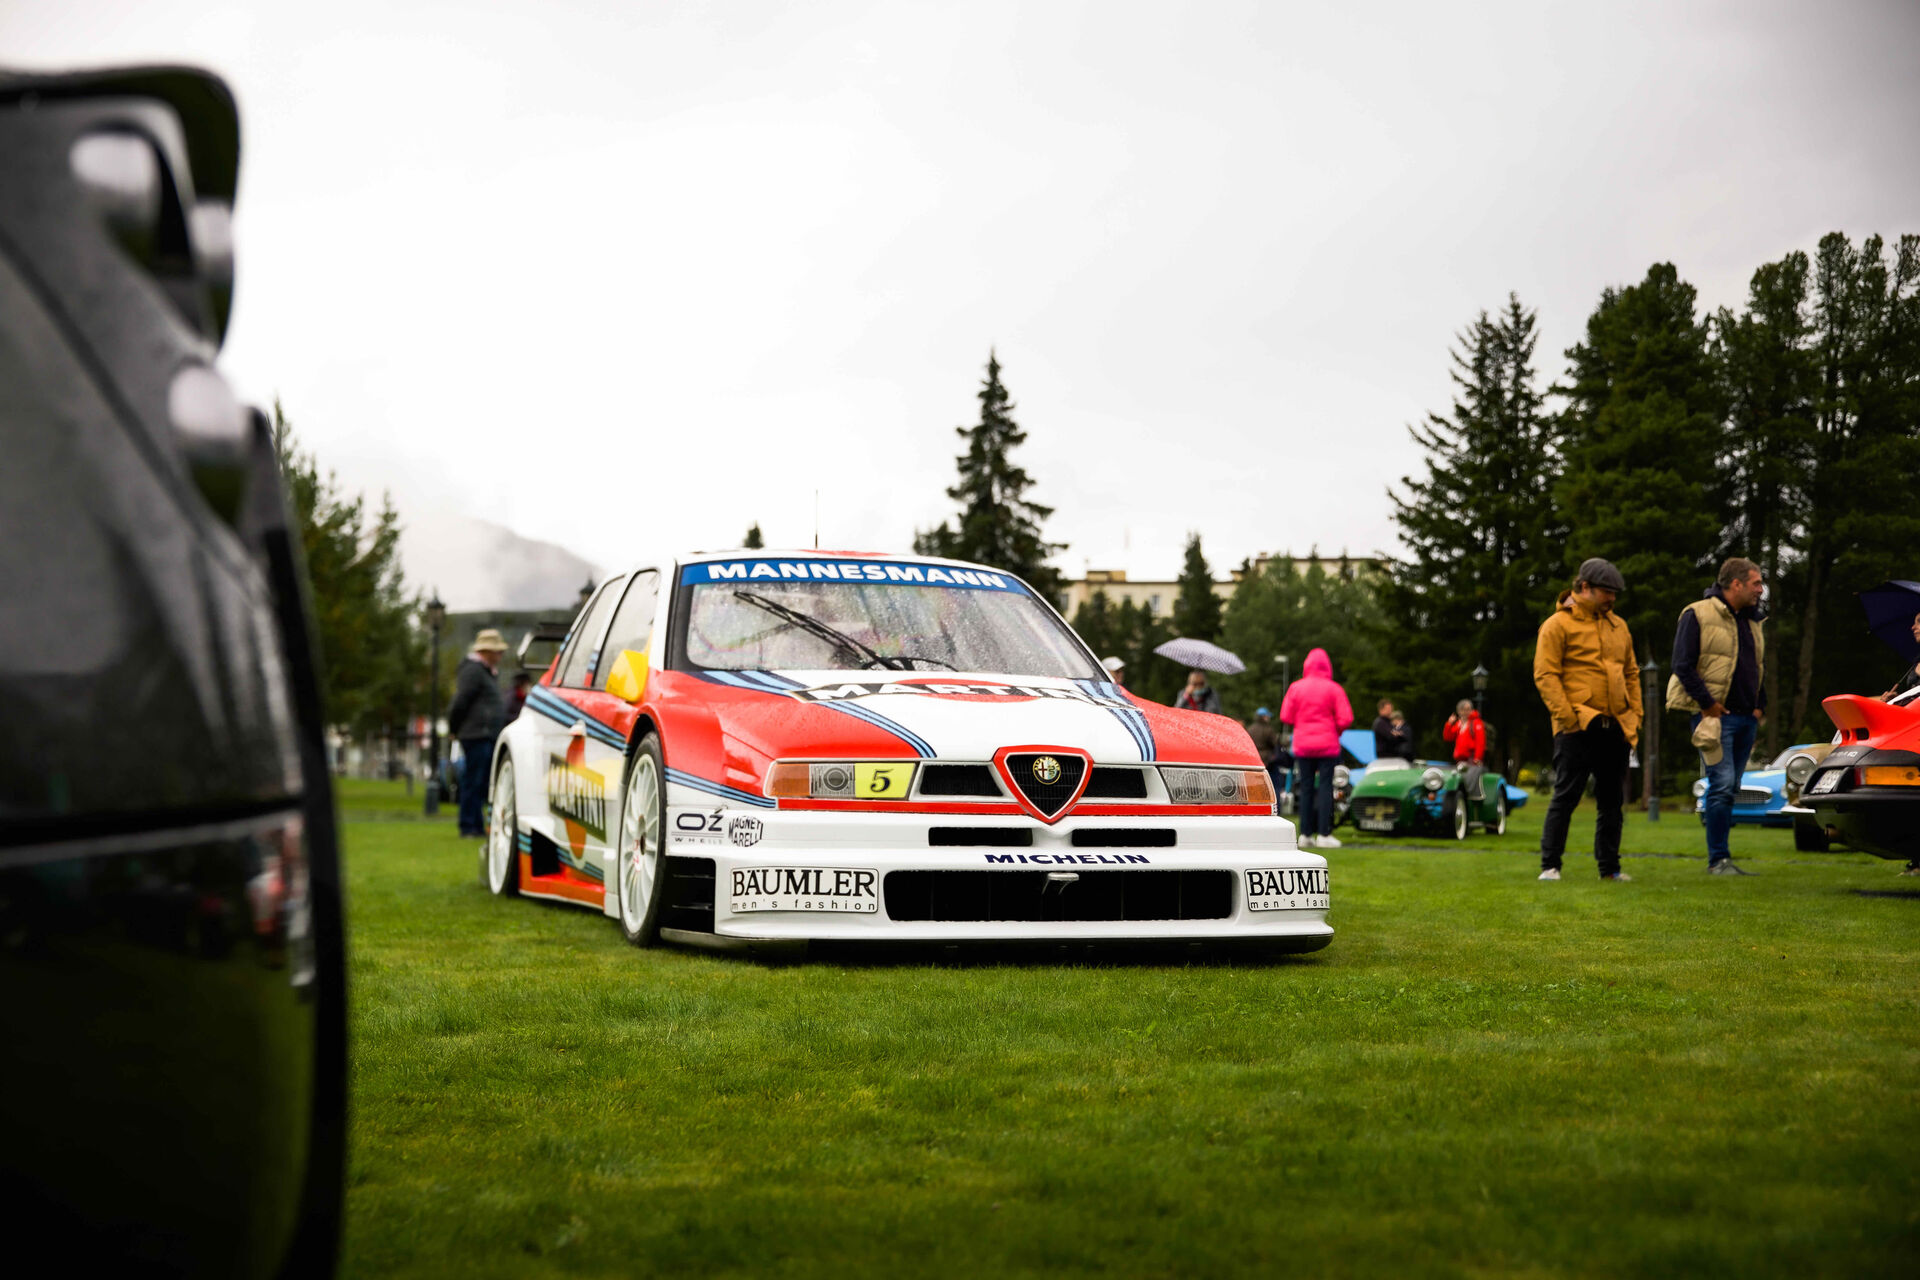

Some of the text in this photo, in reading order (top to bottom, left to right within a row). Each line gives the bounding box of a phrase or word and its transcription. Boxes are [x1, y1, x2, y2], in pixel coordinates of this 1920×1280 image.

[707, 562, 1008, 589] MANNESMANN
[870, 768, 895, 793] 5
[984, 854, 1151, 865] MICHELIN
[732, 869, 876, 898] BÄUMLER
[731, 899, 876, 911] men's fashion
[1250, 898, 1296, 909] men's
